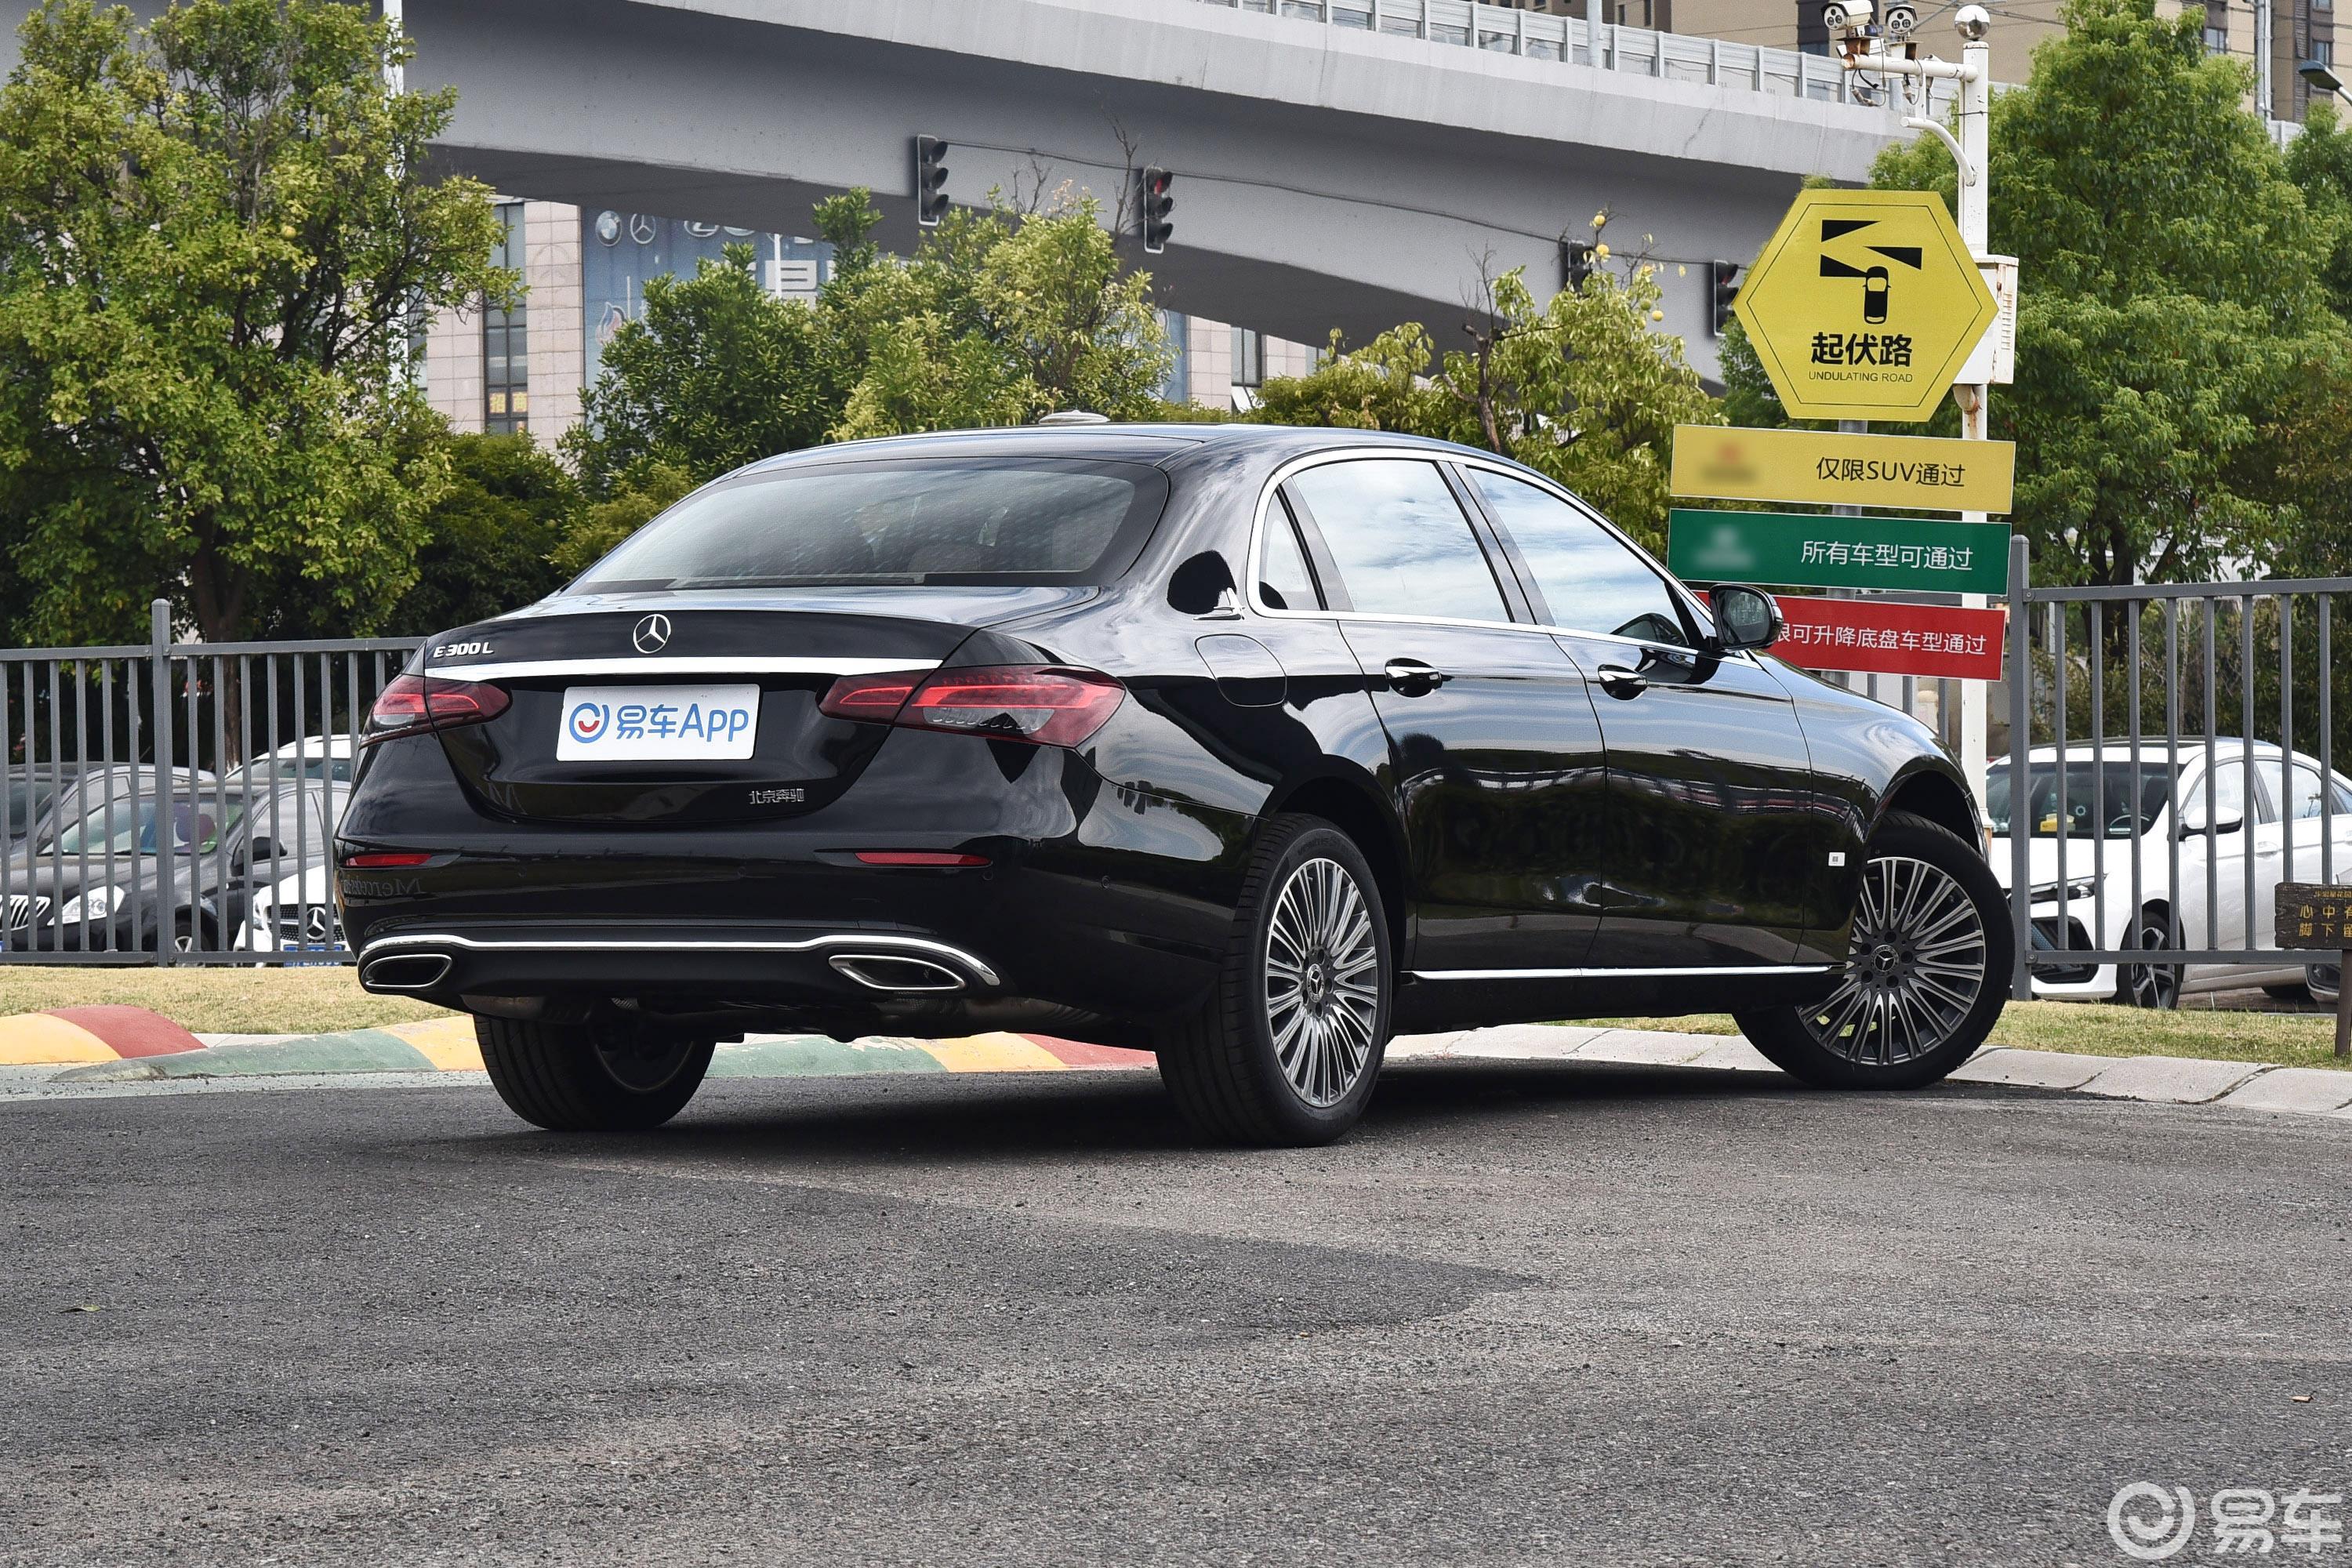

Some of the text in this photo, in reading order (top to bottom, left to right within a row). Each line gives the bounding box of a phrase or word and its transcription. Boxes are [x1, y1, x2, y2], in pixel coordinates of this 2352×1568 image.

[1811, 332, 1912, 367] 起伏路
[1809, 371, 1913, 383] UNDULATING ROAD
[1816, 456, 1965, 488] 仅限SUV通过
[1801, 540, 1973, 571] 所有车型可通过
